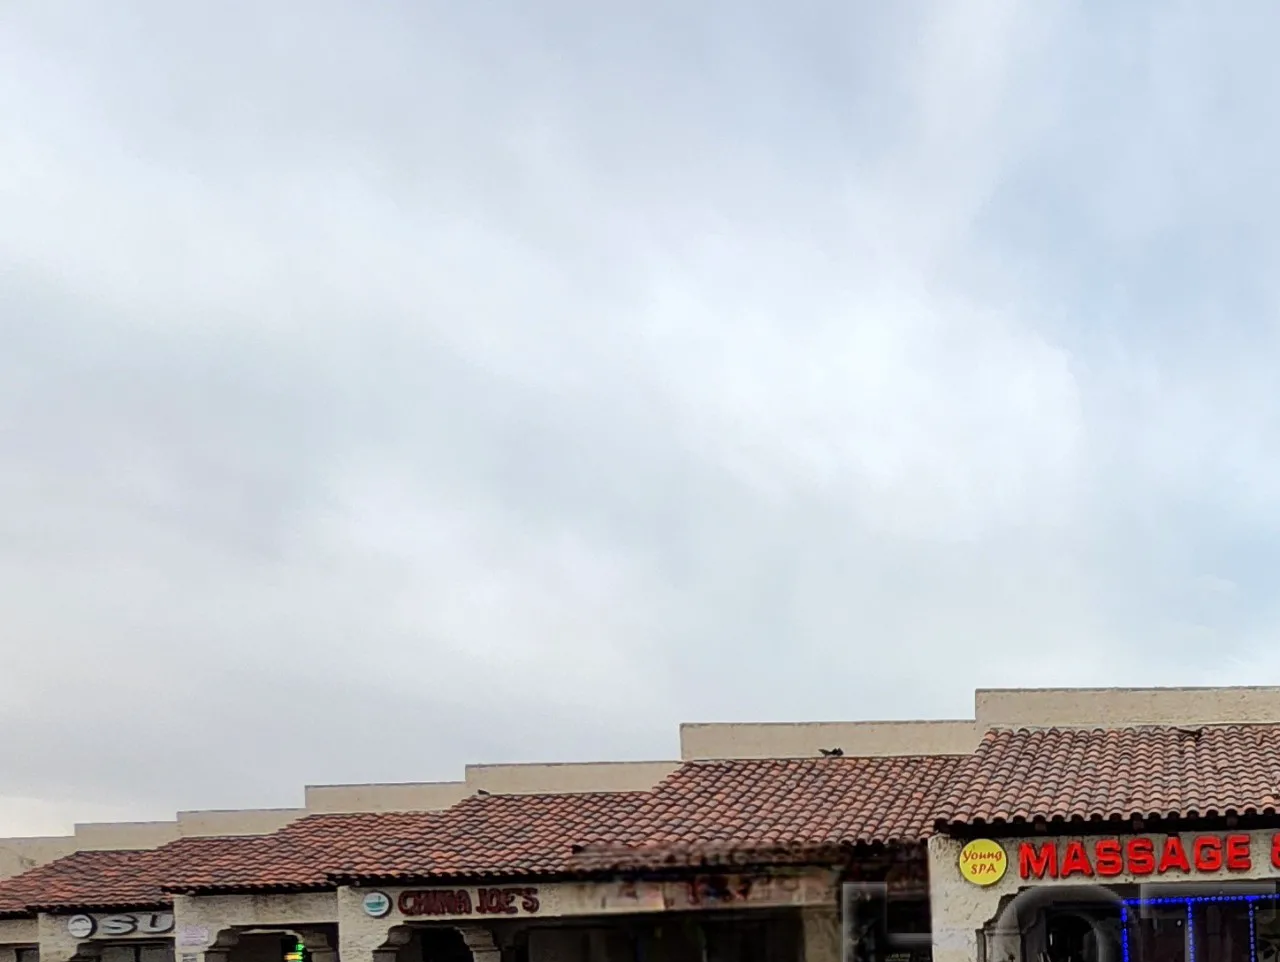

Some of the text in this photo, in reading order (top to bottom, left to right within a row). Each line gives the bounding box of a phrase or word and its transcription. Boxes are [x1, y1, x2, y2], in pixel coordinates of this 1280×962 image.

[962, 849, 1003, 864] Young
[1018, 834, 1251, 878] MASSAGE
[970, 863, 997, 875] SPA
[398, 887, 541, 916] CHINA JOE'S
